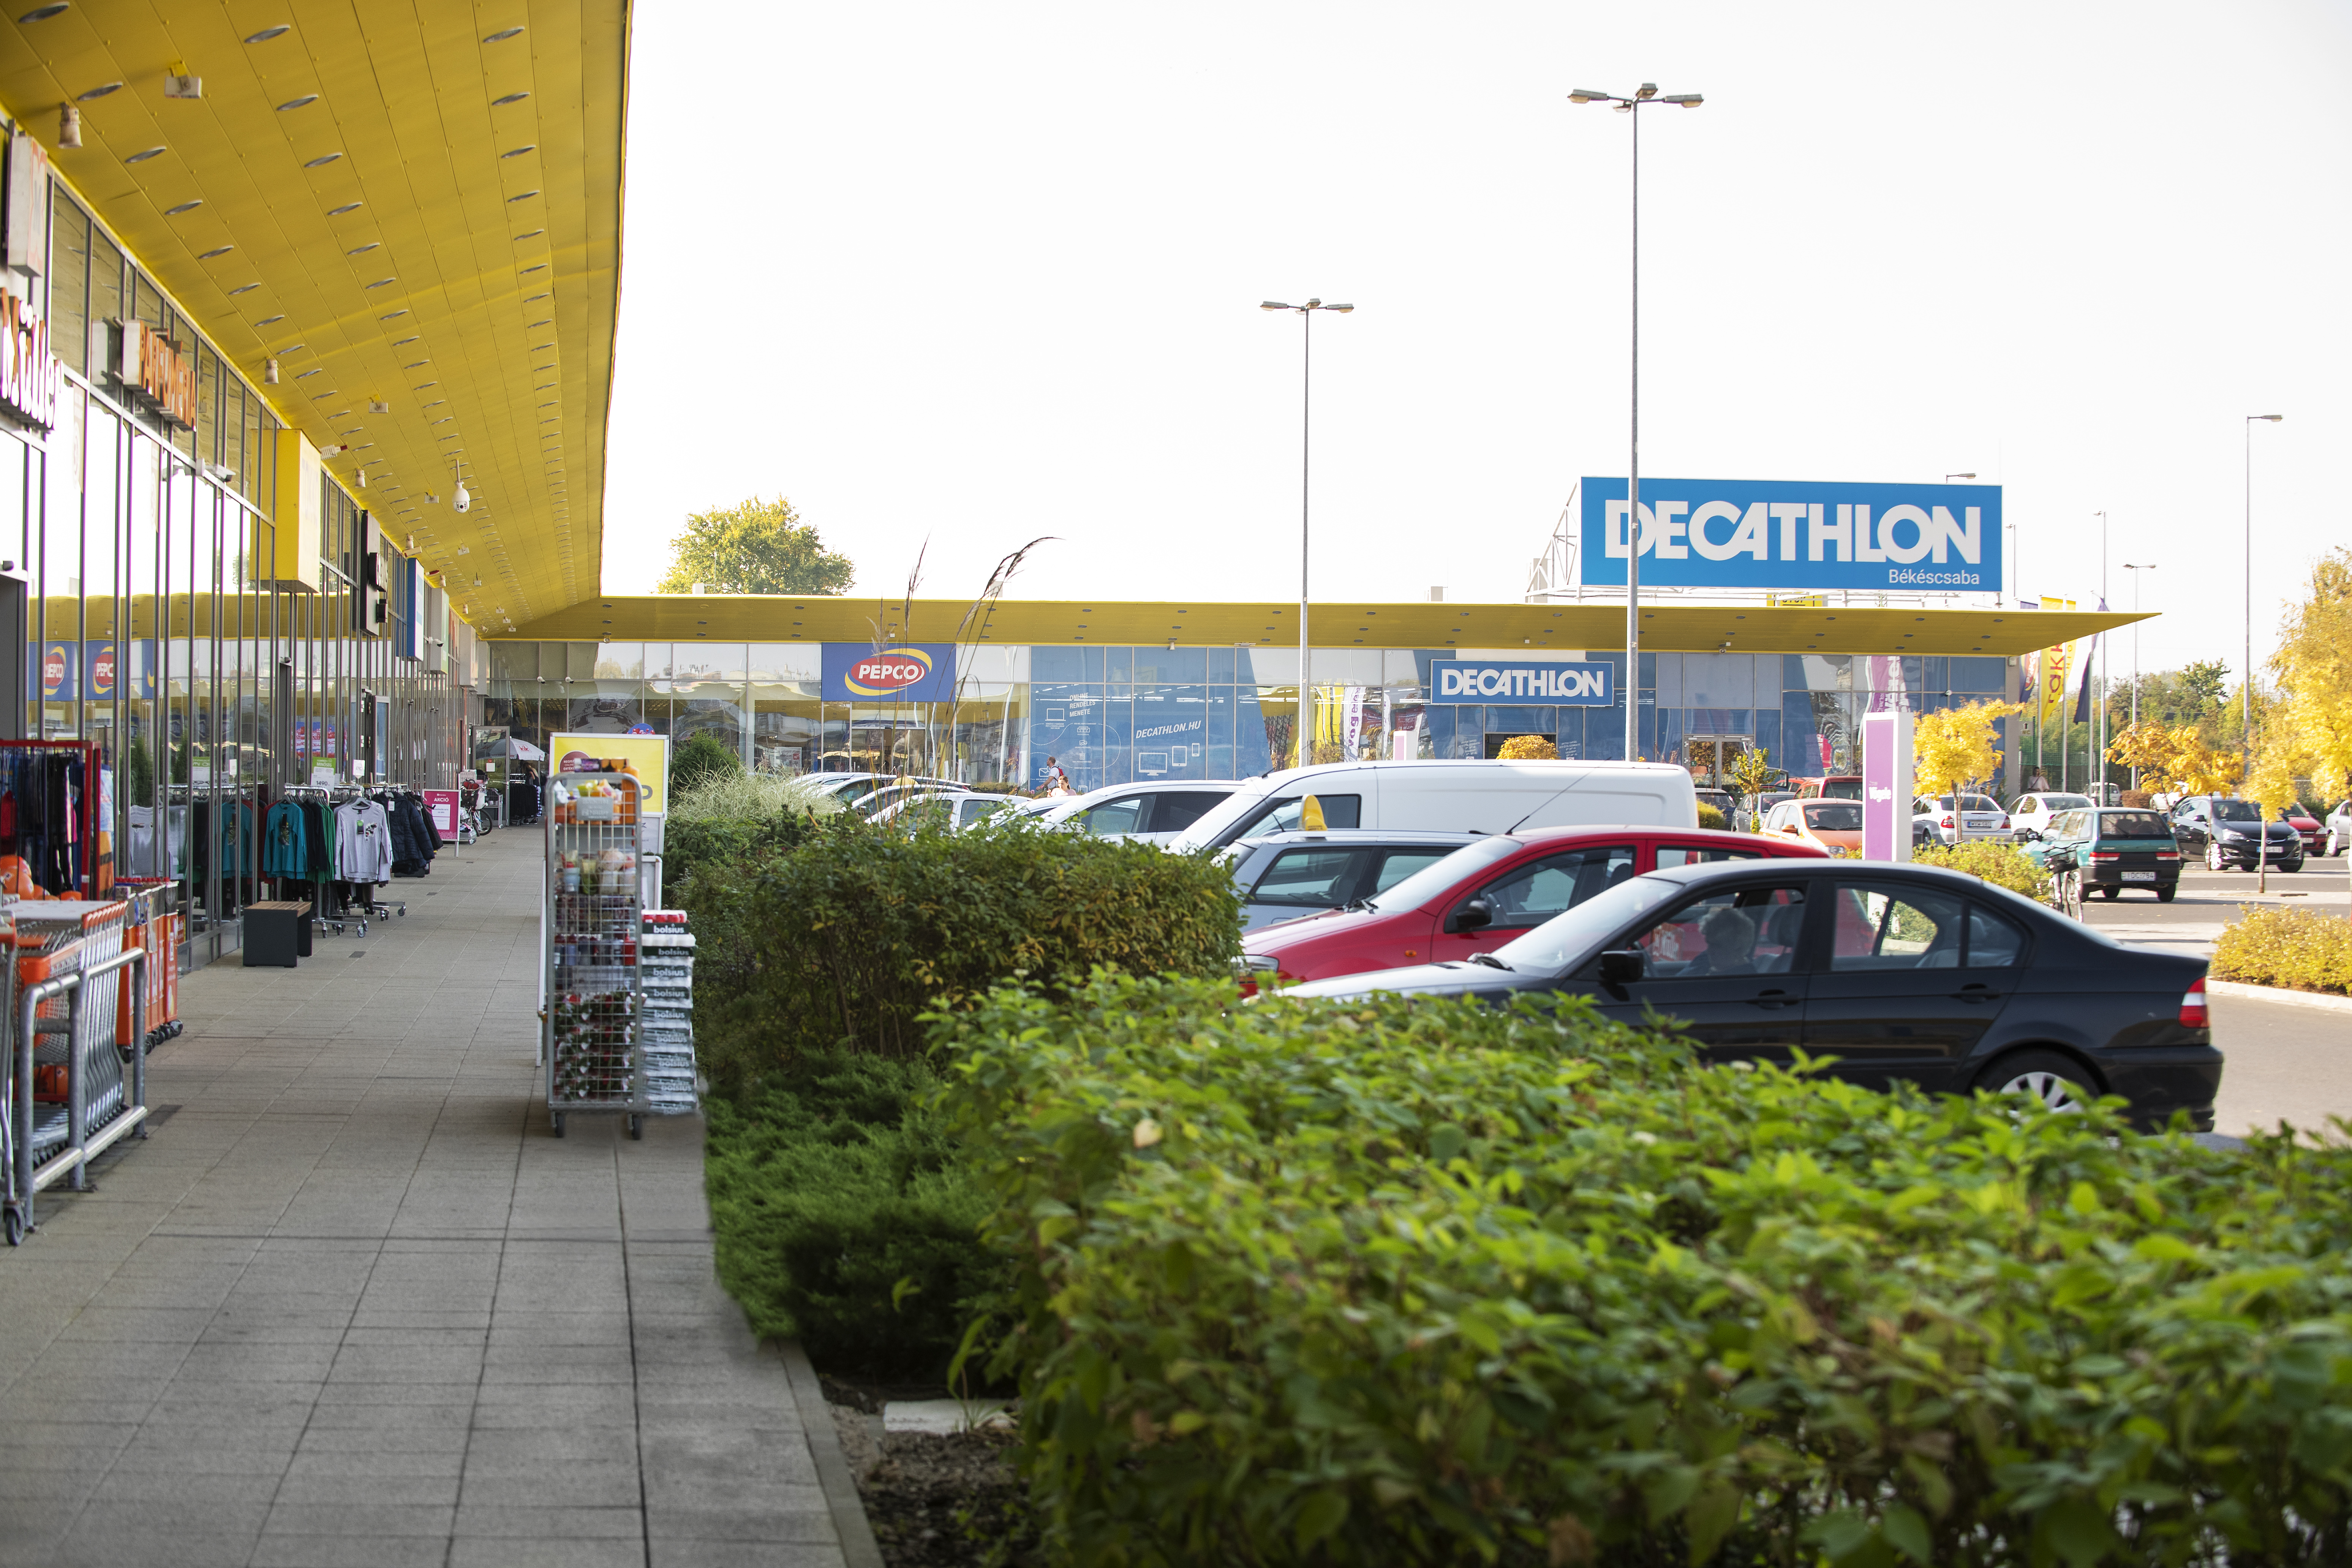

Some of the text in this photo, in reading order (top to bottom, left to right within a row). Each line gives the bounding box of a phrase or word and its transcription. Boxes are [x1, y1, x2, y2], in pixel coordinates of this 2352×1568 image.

[1605, 499, 1981, 564] DECATHLON
[1889, 568, 1980, 585] Békéscsaba
[858, 664, 919, 679] PEPCO
[1441, 669, 1604, 697] DECATHLON
[1069, 692, 1089, 701] ONLINE
[1070, 708, 1091, 718] MENETE
[1135, 720, 1201, 739] DECATHLON.HU
[653, 923, 684, 933] bolsius
[659, 947, 689, 956] bolsius
[653, 966, 685, 976] bolsius
[653, 988, 685, 997] bolsius
[654, 1009, 685, 1018] bolsius
